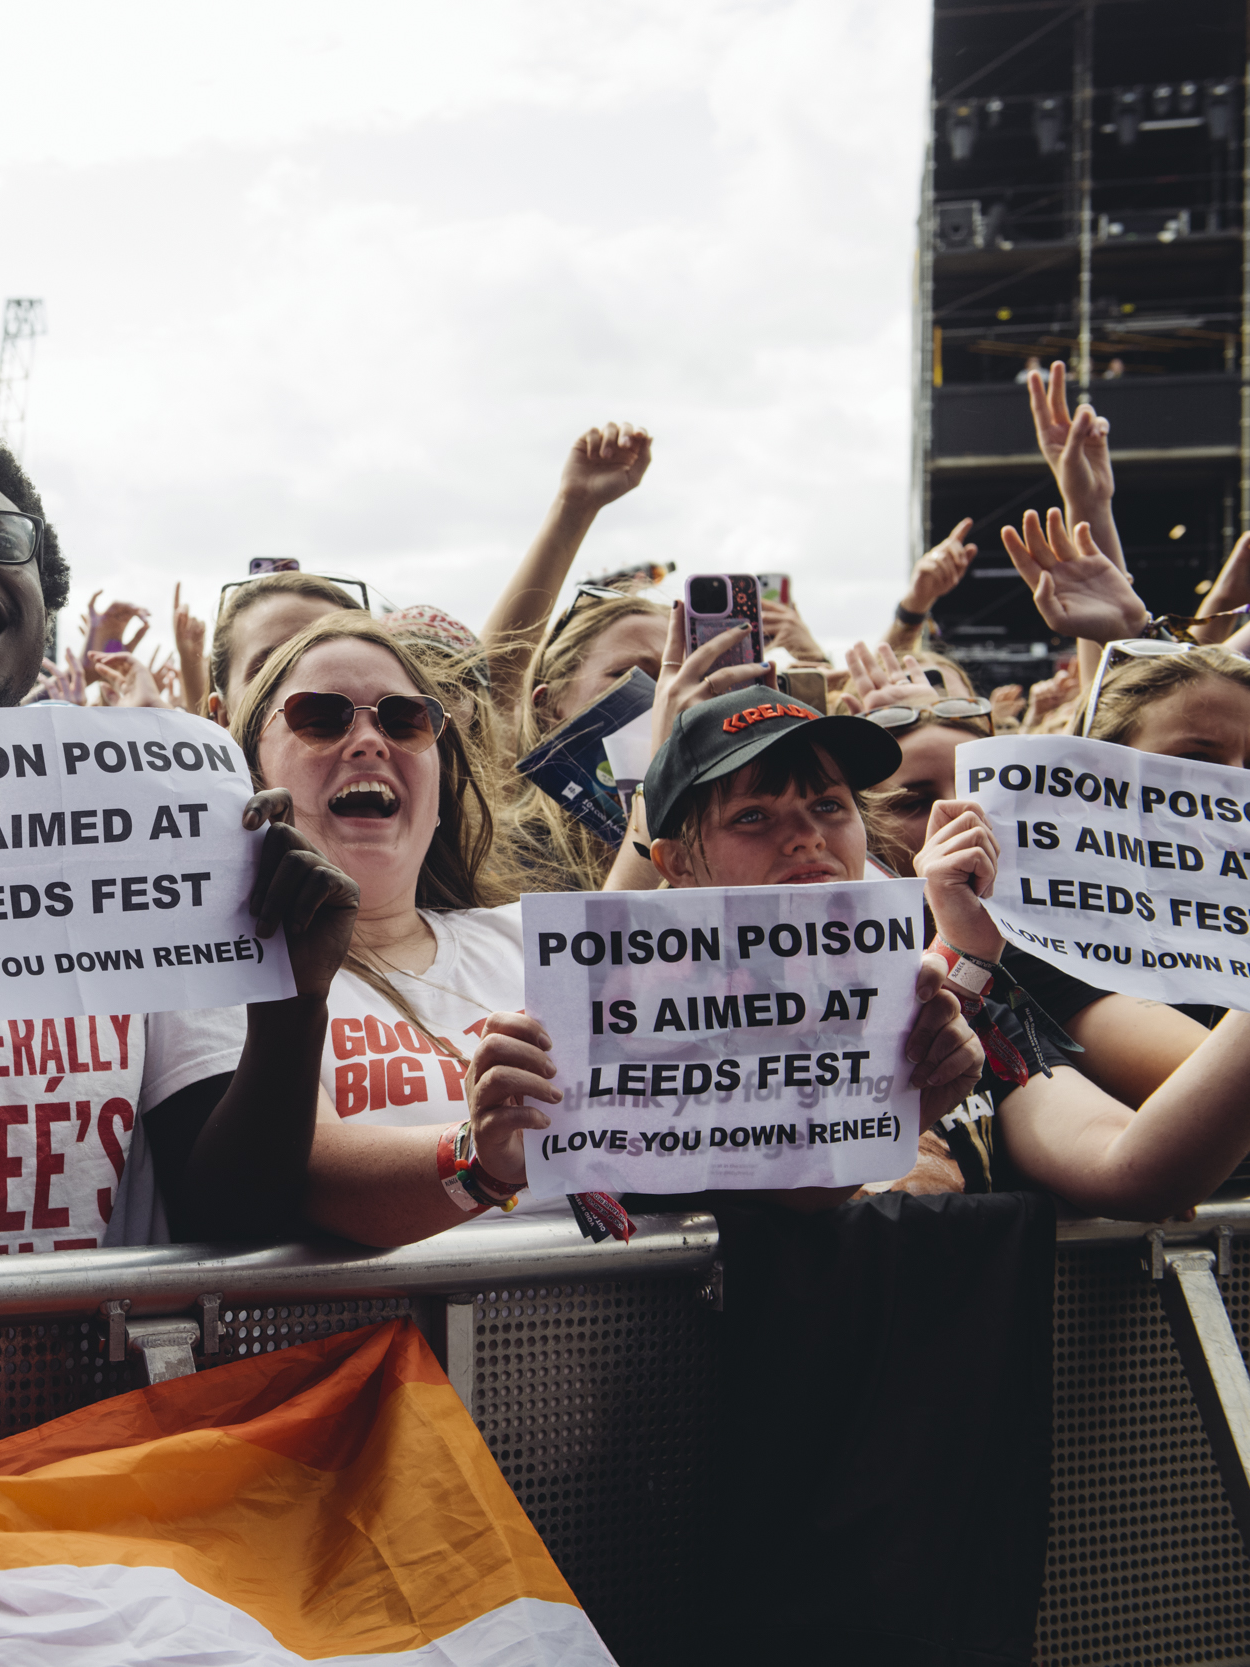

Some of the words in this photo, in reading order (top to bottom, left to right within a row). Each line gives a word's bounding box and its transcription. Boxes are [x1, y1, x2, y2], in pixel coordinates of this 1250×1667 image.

[63, 739, 237, 776] POISON
[969, 764, 1130, 810] POISON
[1141, 785, 1250, 823] POIS
[149, 803, 209, 841] AT
[1016, 820, 1060, 850] IS
[1075, 826, 1204, 873] AIMED
[1219, 850, 1250, 880] A
[92, 871, 212, 914] FEST
[1020, 877, 1156, 922] LEEDS
[1169, 898, 1250, 935] FES
[54, 948, 144, 974] DOWN
[153, 934, 265, 968] RENEÉ)
[538, 925, 721, 968] POISON
[737, 917, 917, 961] POISON
[1000, 918, 1068, 955] (LOVE
[1073, 942, 1132, 965] YOU
[1141, 949, 1223, 973] DOWN
[1230, 959, 1250, 979] R
[591, 999, 638, 1035] IS
[653, 992, 808, 1033] AIMED
[818, 987, 879, 1023] AT
[335, 1055, 429, 1119] BIG
[589, 1057, 742, 1099] LEEDS
[757, 1050, 870, 1090] FEST
[541, 1129, 628, 1160] (LOVE
[639, 1131, 701, 1152] YOU
[709, 1124, 797, 1148] DOWN
[808, 1112, 901, 1145] RENEÉ)
[595, 1218, 606, 1232] CUT
